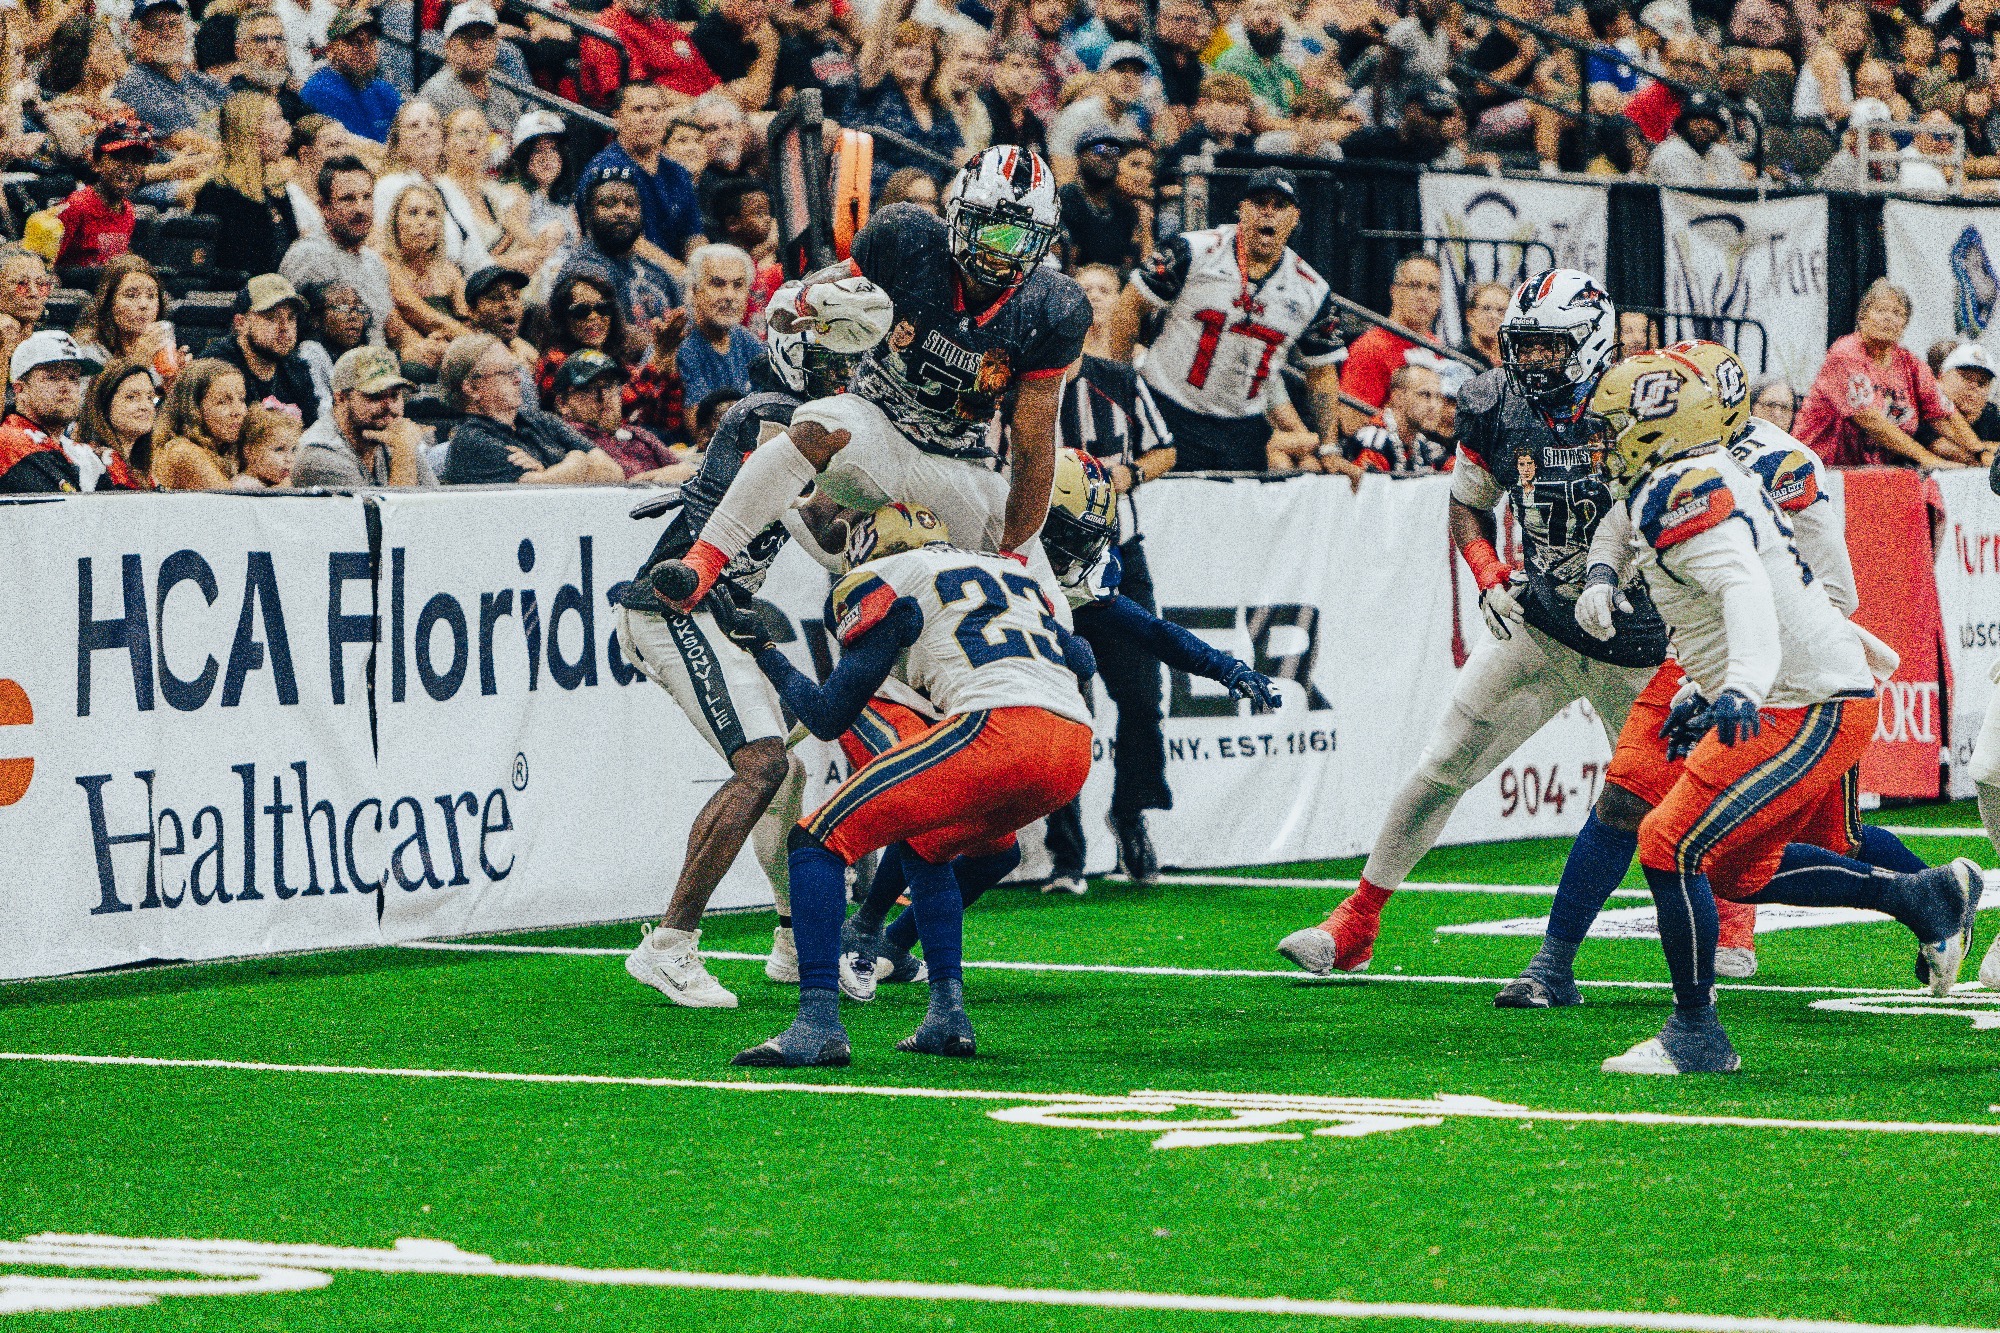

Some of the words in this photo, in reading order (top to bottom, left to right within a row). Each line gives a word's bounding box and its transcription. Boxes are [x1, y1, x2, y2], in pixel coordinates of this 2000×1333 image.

[922, 329, 982, 374] SHARKS
[1186, 308, 1287, 400] 17
[1543, 445, 1591, 471] SHARKS
[76, 549, 299, 717] HCA
[933, 565, 1067, 670] 23
[1218, 734, 1277, 759] EST.
